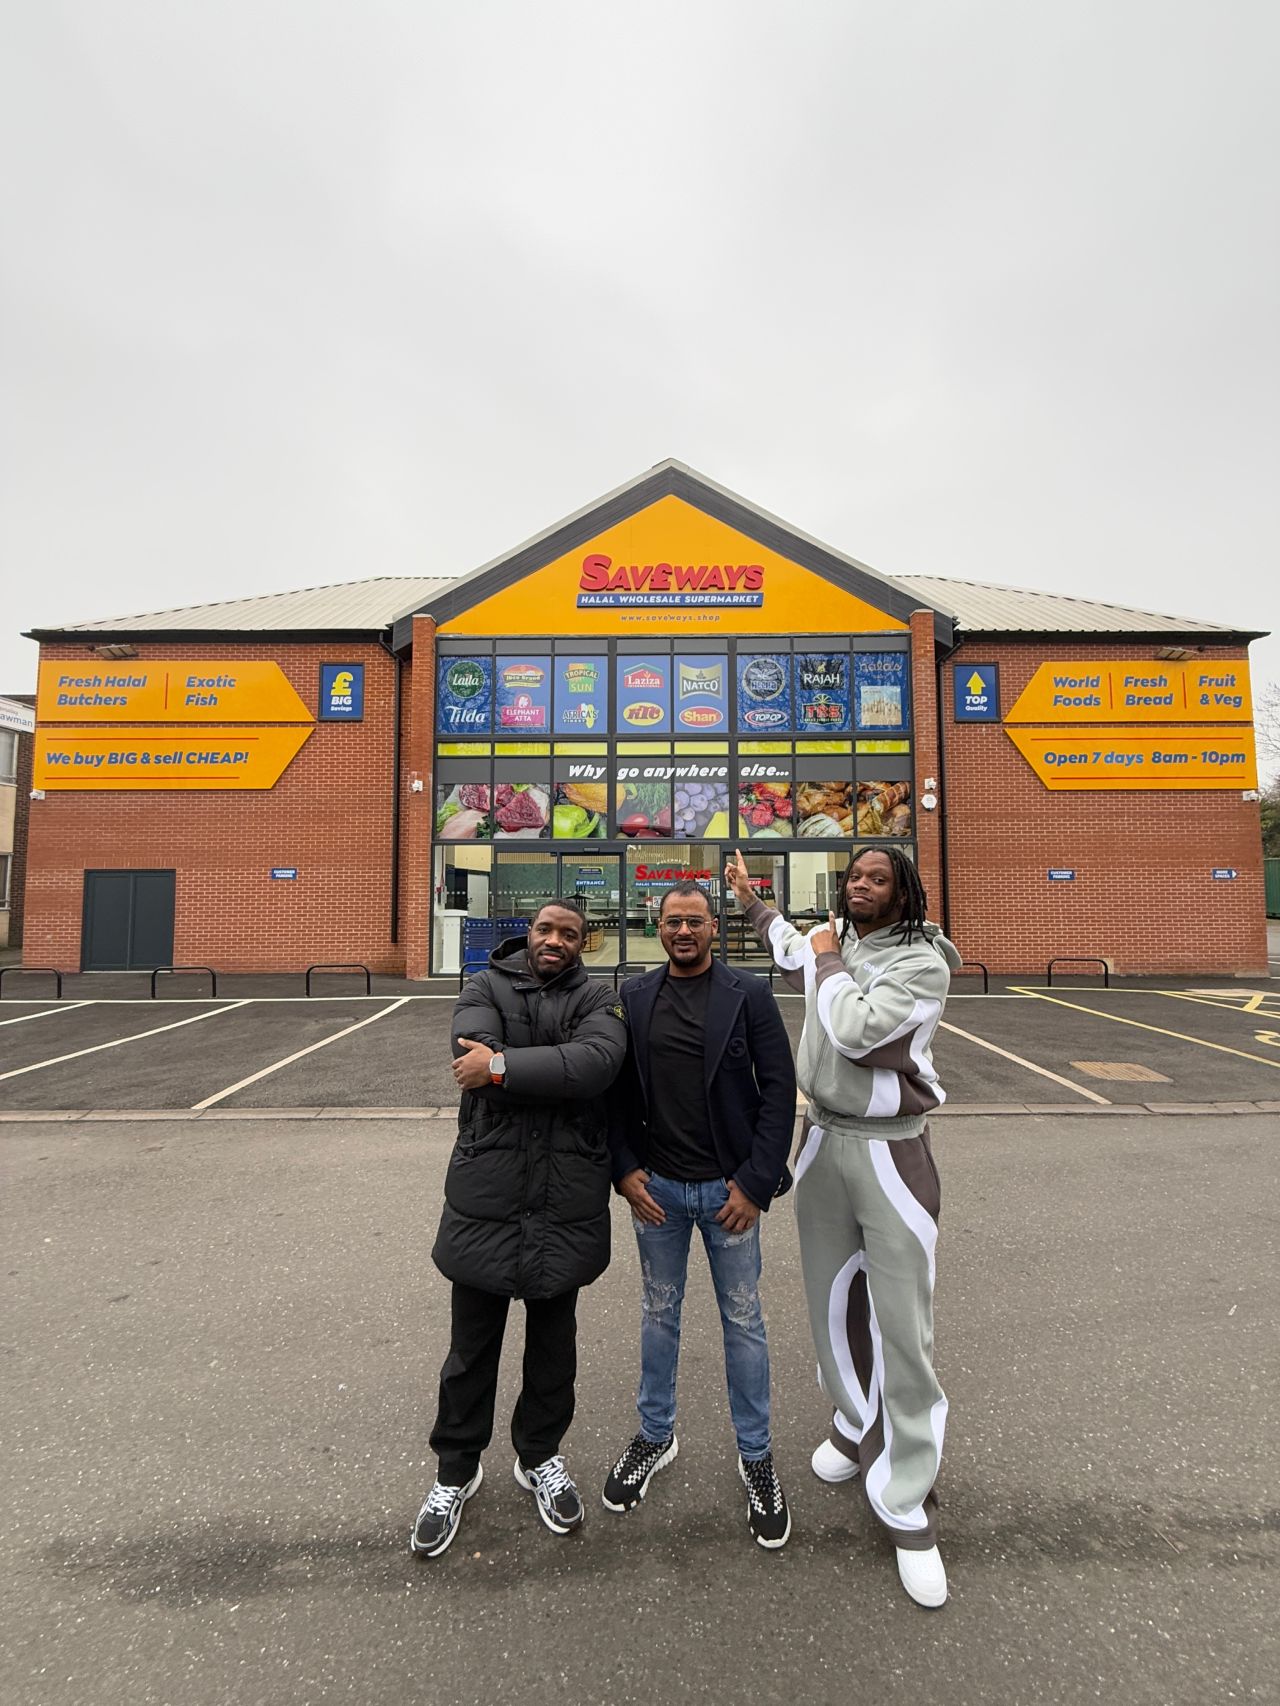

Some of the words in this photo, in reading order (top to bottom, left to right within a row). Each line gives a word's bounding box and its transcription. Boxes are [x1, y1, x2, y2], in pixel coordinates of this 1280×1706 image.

[581, 596, 615, 604] HALAL
[619, 595, 681, 604] WHOLESALE
[684, 595, 759, 604] SUPERMARKET
[620, 613, 721, 623] www.saveways.shop
[452, 673, 480, 686] Laila
[564, 670, 598, 680] TROPICAL
[627, 675, 661, 685] Laziza
[803, 673, 840, 685] RAJAH
[1198, 674, 1237, 688] Fruit
[58, 675, 102, 688] Fresh
[104, 675, 147, 688] Halal
[185, 675, 237, 688] Exotic
[571, 683, 593, 692] SUN
[683, 679, 718, 692] NATCO
[1052, 676, 1100, 688] World
[1123, 675, 1168, 688] Fresh
[57, 694, 128, 706] Butchers
[185, 694, 218, 706] Fish
[331, 696, 352, 705] BIG
[965, 696, 988, 704] TOP
[1052, 694, 1101, 706] Foods
[1125, 693, 1174, 706] Bread
[1199, 694, 1210, 705] &
[1213, 694, 1243, 708] Veg
[445, 705, 486, 723] Tilda
[562, 710, 598, 720] AFRICA'S
[684, 710, 717, 722] Shan
[805, 704, 841, 718] TRS
[46, 752, 76, 765] We
[77, 752, 105, 767] buy
[107, 752, 138, 765] BIG
[140, 752, 151, 764] &
[153, 751, 183, 764] sell
[185, 751, 249, 764] CHEAP!
[1043, 752, 1088, 766] Open
[1091, 752, 1102, 764] 7
[1103, 751, 1144, 767] days
[1151, 751, 1188, 764] 8am
[1200, 751, 1246, 766] 10pm
[568, 764, 606, 779] Why
[617, 765, 639, 780] go
[643, 764, 728, 779] anywhere
[740, 763, 789, 776] else...
